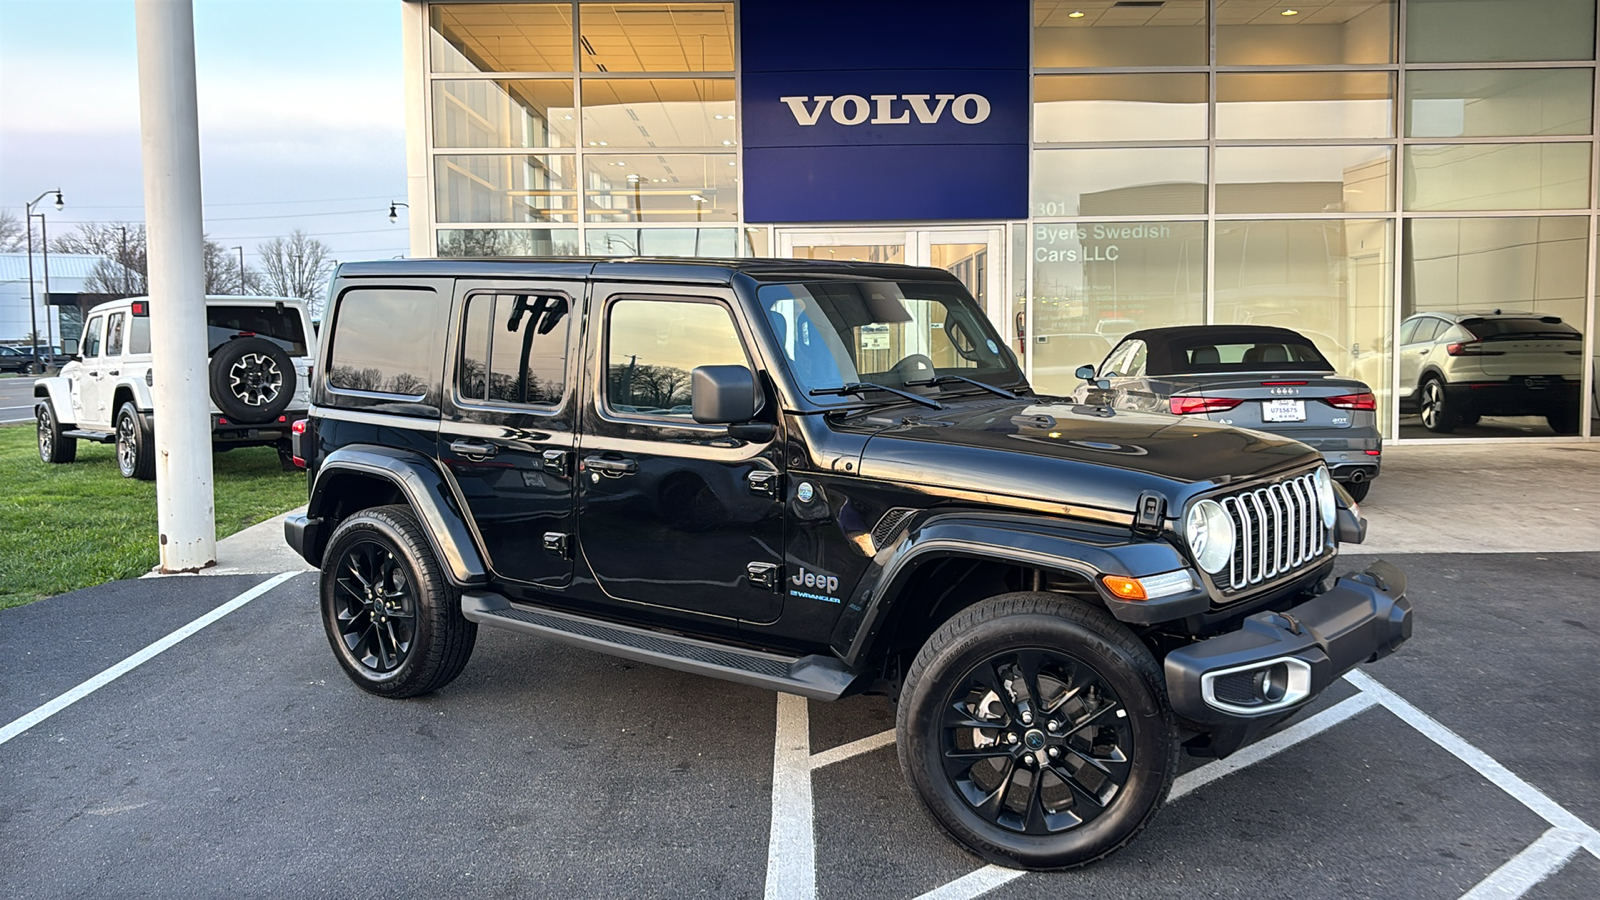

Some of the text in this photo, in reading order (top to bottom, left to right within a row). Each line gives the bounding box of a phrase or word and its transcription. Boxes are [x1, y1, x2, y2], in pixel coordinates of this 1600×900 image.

[780, 93, 991, 126] VOLVO
[1036, 202, 1066, 216] 301
[1036, 223, 1170, 244] Byers Swedish
[1035, 245, 1119, 262] Cars LLC
[792, 567, 839, 594] Jeep
[797, 591, 840, 604] WRANGLER
